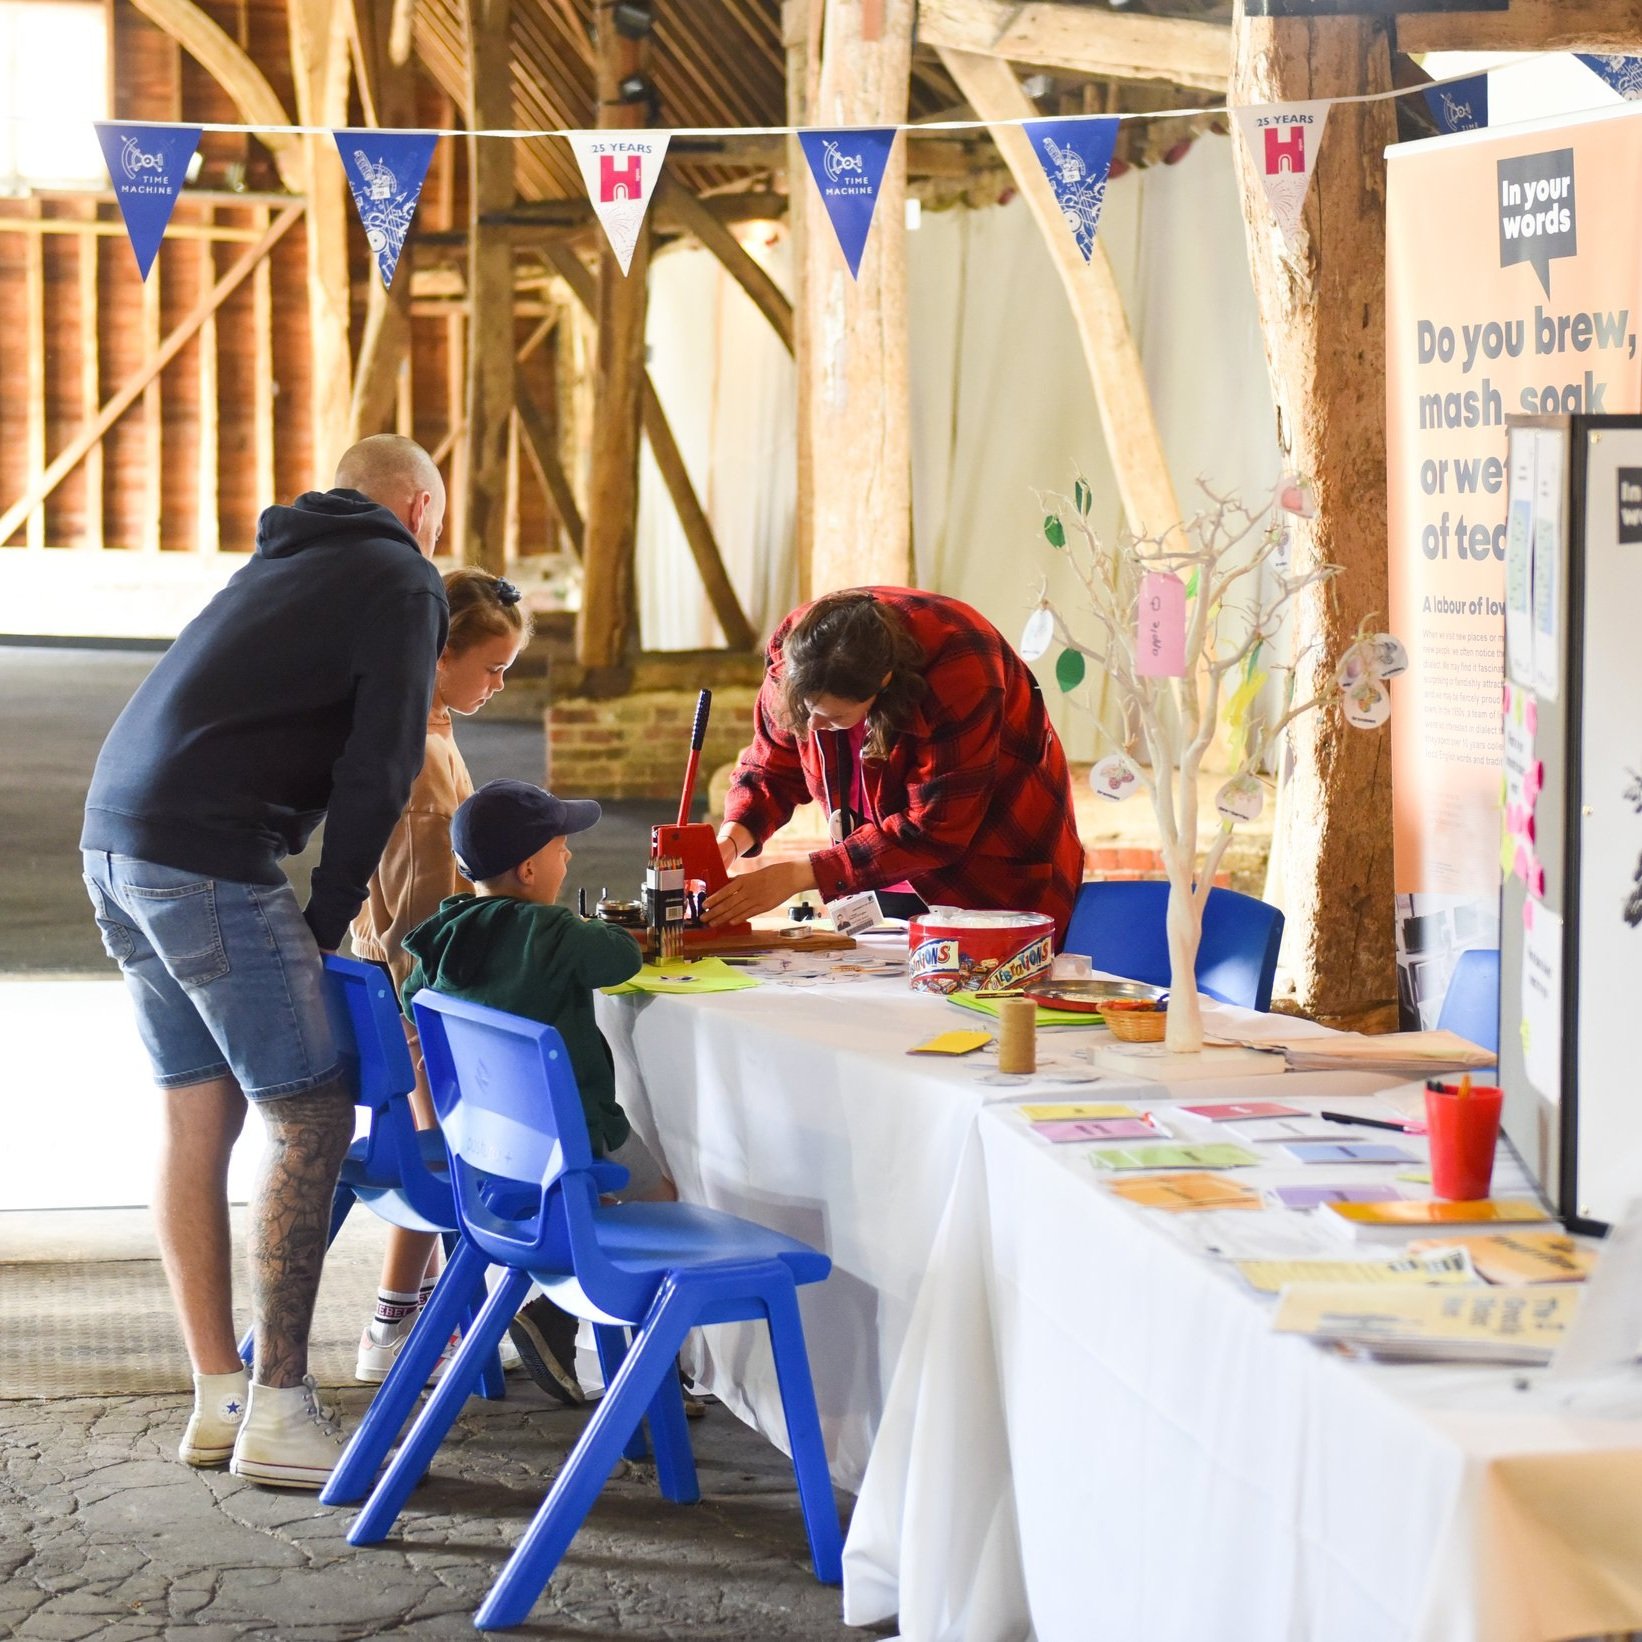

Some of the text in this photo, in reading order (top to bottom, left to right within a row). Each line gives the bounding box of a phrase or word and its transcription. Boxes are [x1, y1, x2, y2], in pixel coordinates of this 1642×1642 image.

[1257, 114, 1314, 127] 25 YEARS
[591, 143, 652, 154] 25 YEARS
[121, 185, 173, 195] MACHINE
[143, 175, 169, 185] TIME
[825, 186, 873, 195] MACHINE
[844, 176, 869, 185] TIME
[1502, 176, 1571, 211] In your
[1502, 202, 1571, 240] words
[1417, 305, 1636, 374] Do you brew,
[1419, 370, 1607, 429] mash soak
[1421, 459, 1448, 495] or
[1422, 512, 1449, 560] of
[1422, 595, 1505, 616] A labour of lov
[1150, 620, 1162, 656] apple
